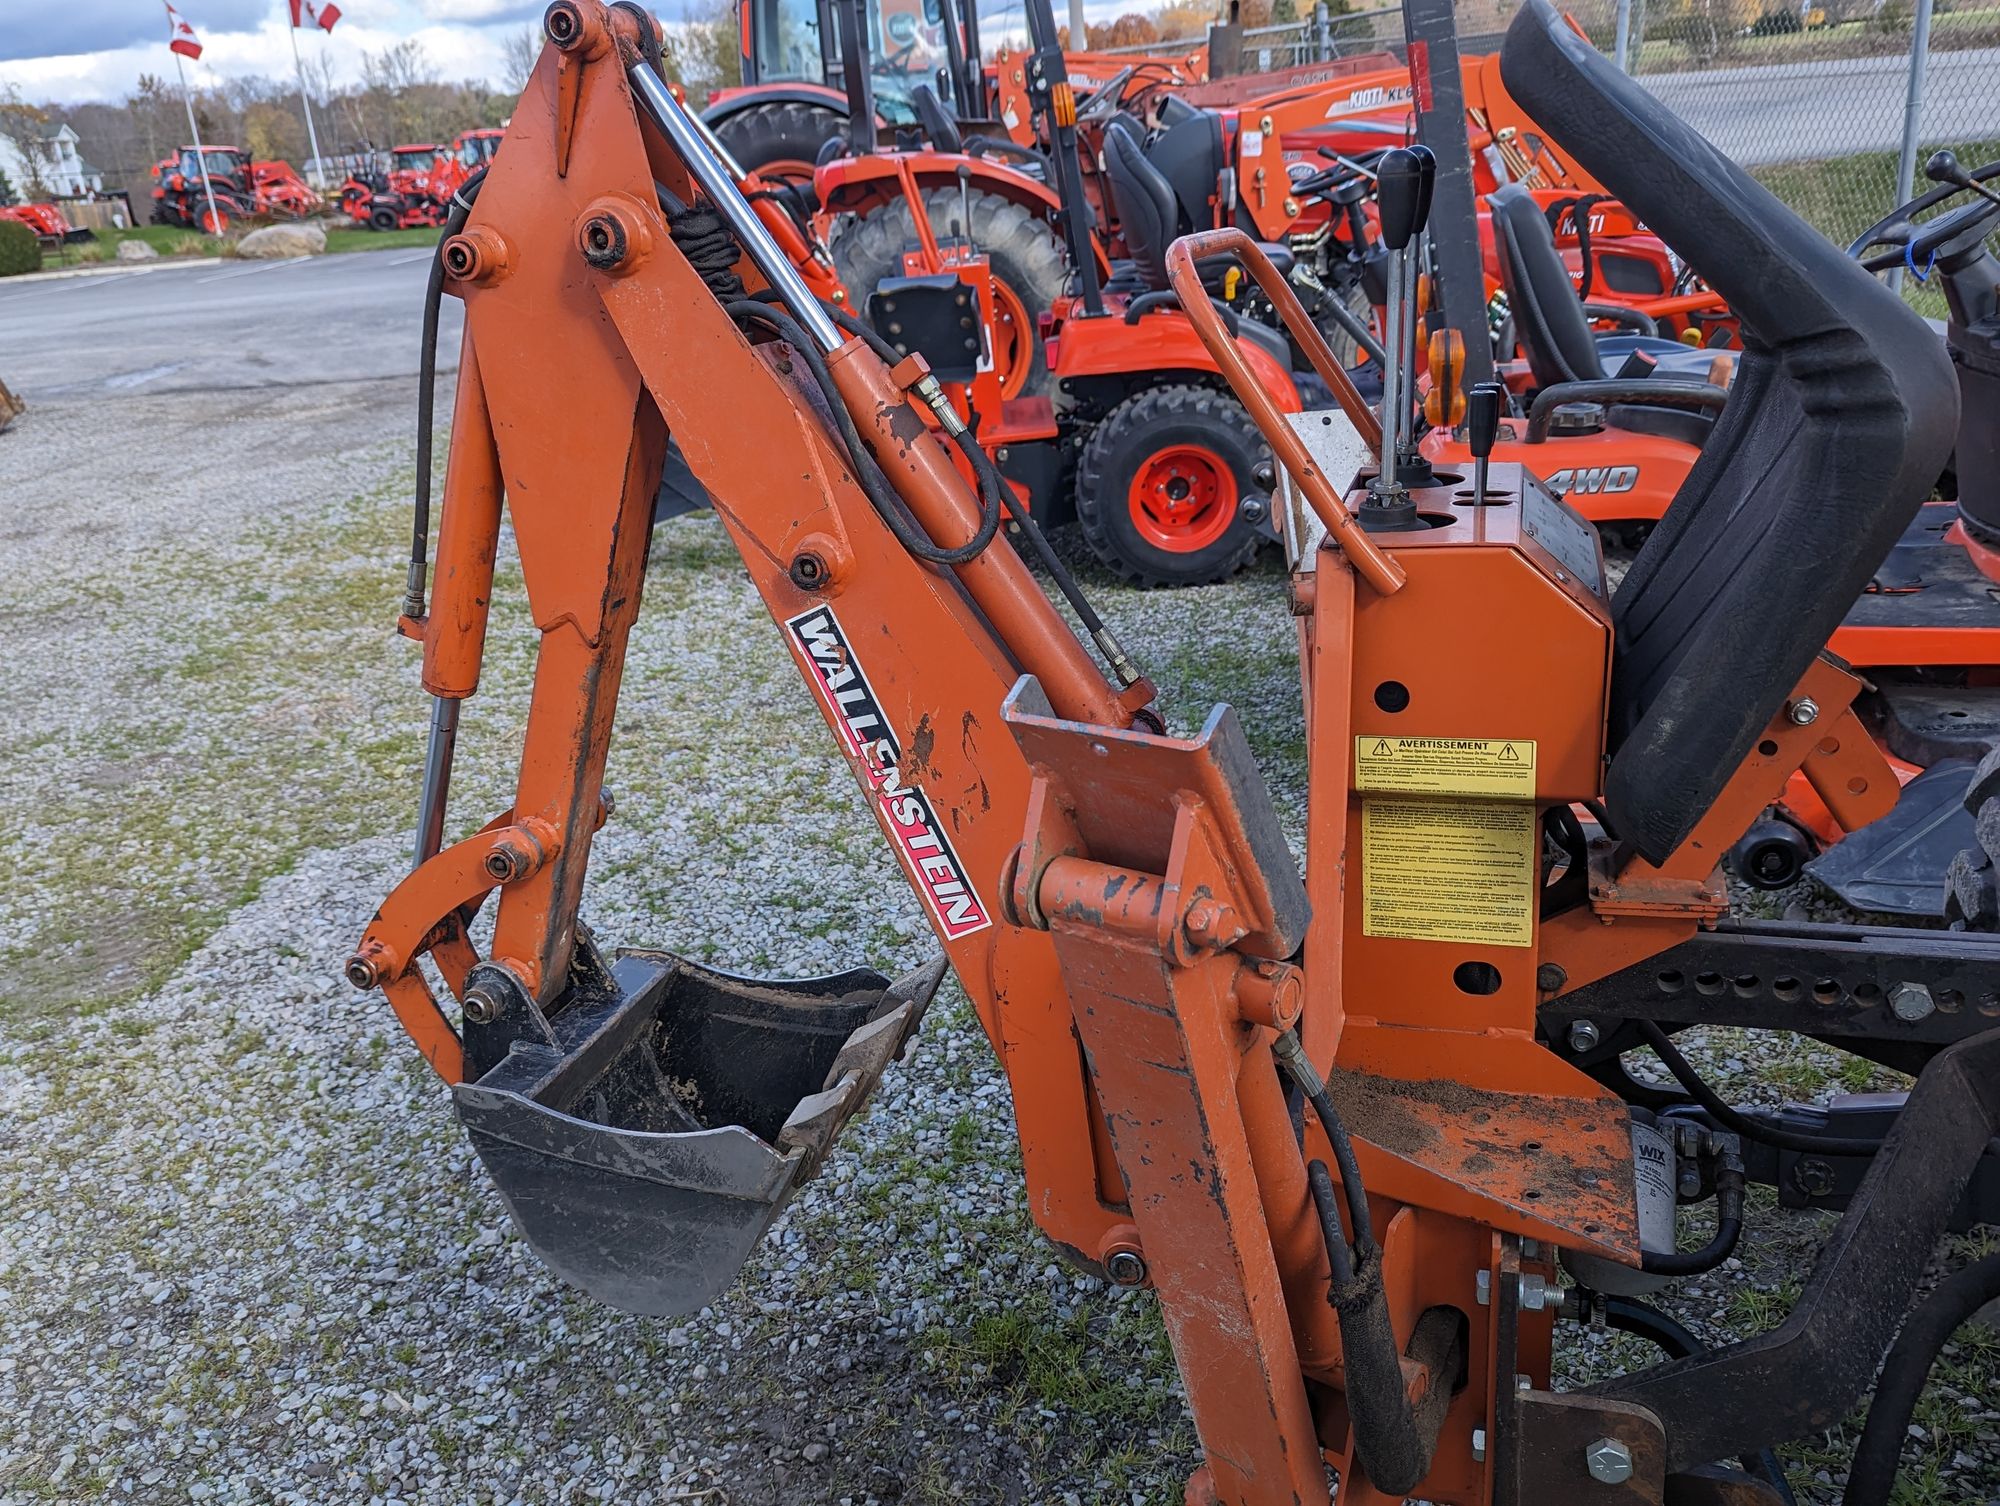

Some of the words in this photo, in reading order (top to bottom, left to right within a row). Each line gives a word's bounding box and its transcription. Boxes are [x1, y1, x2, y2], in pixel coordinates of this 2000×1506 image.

[1349, 86, 1384, 109] KIOTI
[1387, 87, 1403, 102] KL
[1561, 213, 1606, 236] KTI
[1543, 465, 1640, 495] 4WD
[1398, 739, 1490, 751] AVERTISSEMENT
[798, 613, 981, 927] WALLENSTEIN
[1638, 1144, 1666, 1163] WIX
